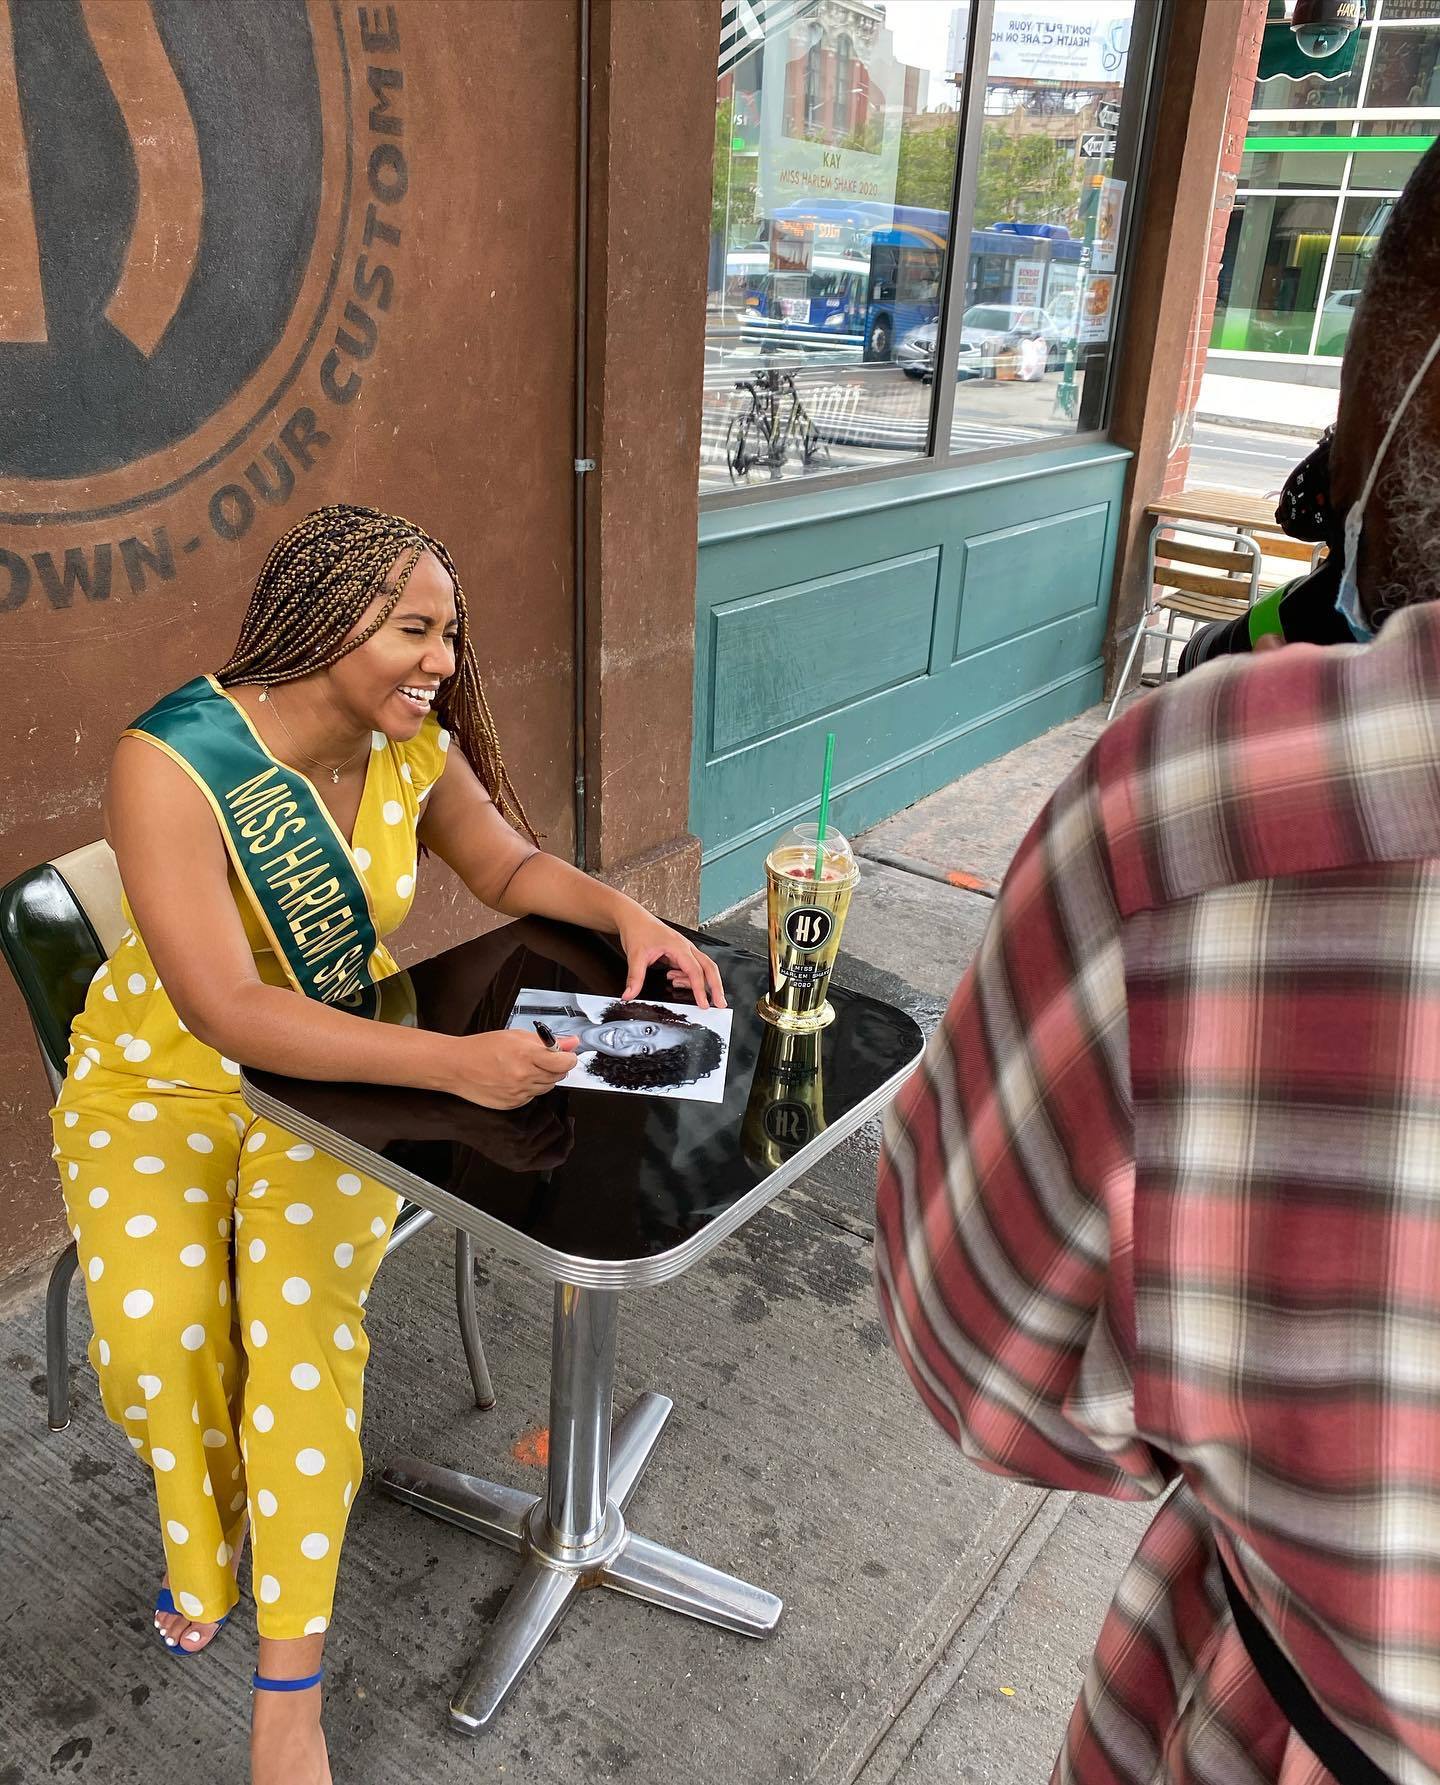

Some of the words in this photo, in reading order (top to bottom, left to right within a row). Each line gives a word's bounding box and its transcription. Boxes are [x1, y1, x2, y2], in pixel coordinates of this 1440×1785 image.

[823, 151, 841, 169] KAY
[780, 169, 800, 185] MISS
[802, 171, 832, 189] HARLEM
[834, 177, 857, 193] SHAKE
[859, 182, 878, 196] 2020
[208, 407, 332, 541] OUR
[320, 5, 408, 405] CUSTOME
[225, 766, 307, 854] MISS
[260, 836, 359, 967] HARLEM
[796, 915, 822, 943] HS
[781, 969, 808, 979] HARLEM
